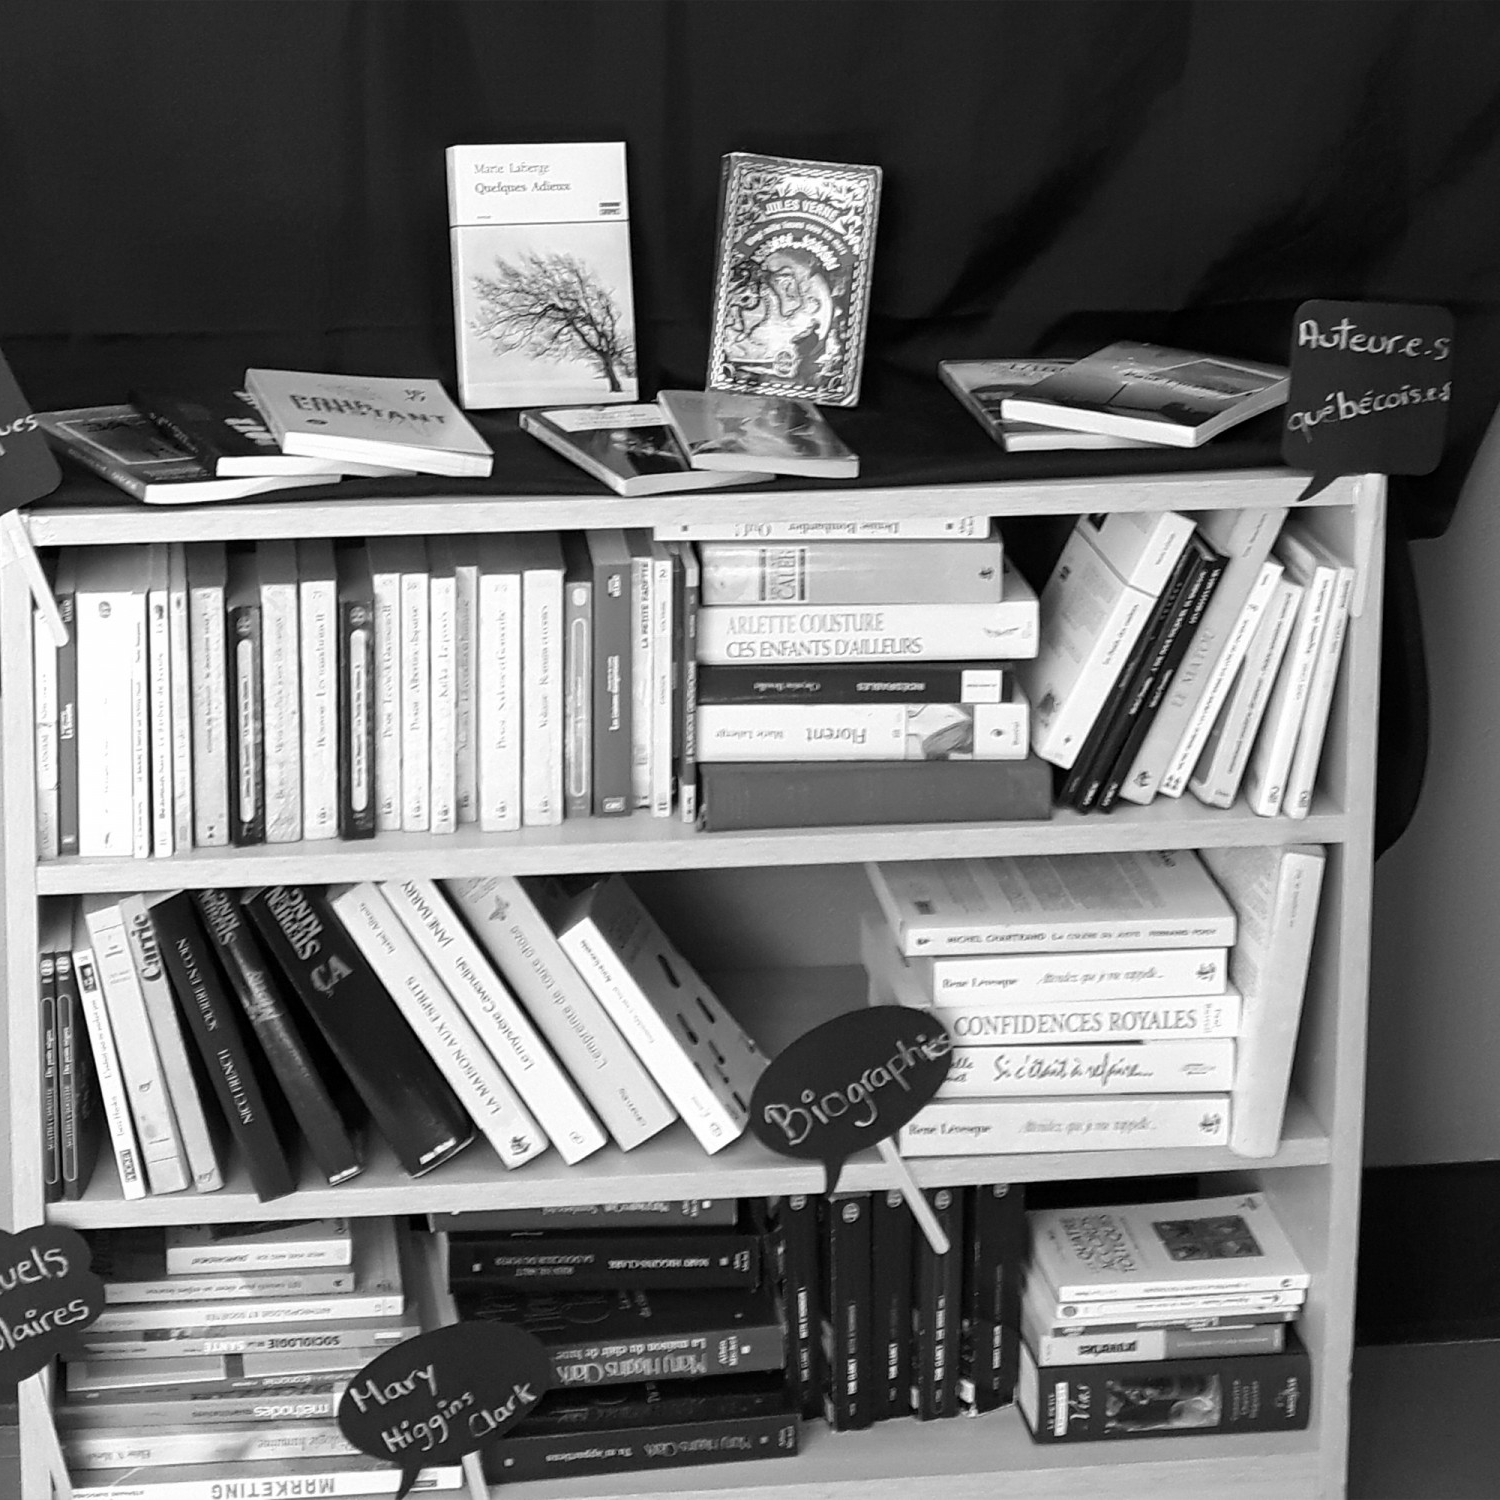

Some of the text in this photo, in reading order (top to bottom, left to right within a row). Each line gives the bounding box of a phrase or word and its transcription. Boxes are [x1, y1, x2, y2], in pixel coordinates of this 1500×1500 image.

[474, 181, 528, 195] Quelques
[764, 199, 840, 222] JULES VERNE
[726, 613, 885, 635] ARLETTE COUSTURE
[726, 636, 924, 659] CES ENFANTS D'AILLEURS
[805, 727, 867, 745] Florent
[259, 883, 325, 962] STEPHEN KING
[398, 877, 455, 949] JANE BARRY
[126, 911, 164, 984] Carrie
[173, 936, 220, 1032] SOURIRE EN COIN
[547, 988, 566, 1007] de
[450, 954, 535, 1071] Le mystère Cavendish
[953, 1009, 1198, 1037] CONFIDENCES ROYALES
[403, 973, 503, 1116] LA MAISON AUX ESPRITS
[558, 1002, 610, 1071] L'empreinte
[215, 1048, 256, 1124] NICCI FRENCH
[266, 1335, 340, 1349] SOCIOLOGIE
[555, 1361, 605, 1385] Clark
[661, 1350, 707, 1376] Mary
[350, 1364, 437, 1413] Mary
[253, 1401, 329, 1420] méthodes
[381, 1391, 475, 1453] Higgins
[468, 1383, 537, 1438] Clark
[210, 1477, 335, 1499] MARKETING
